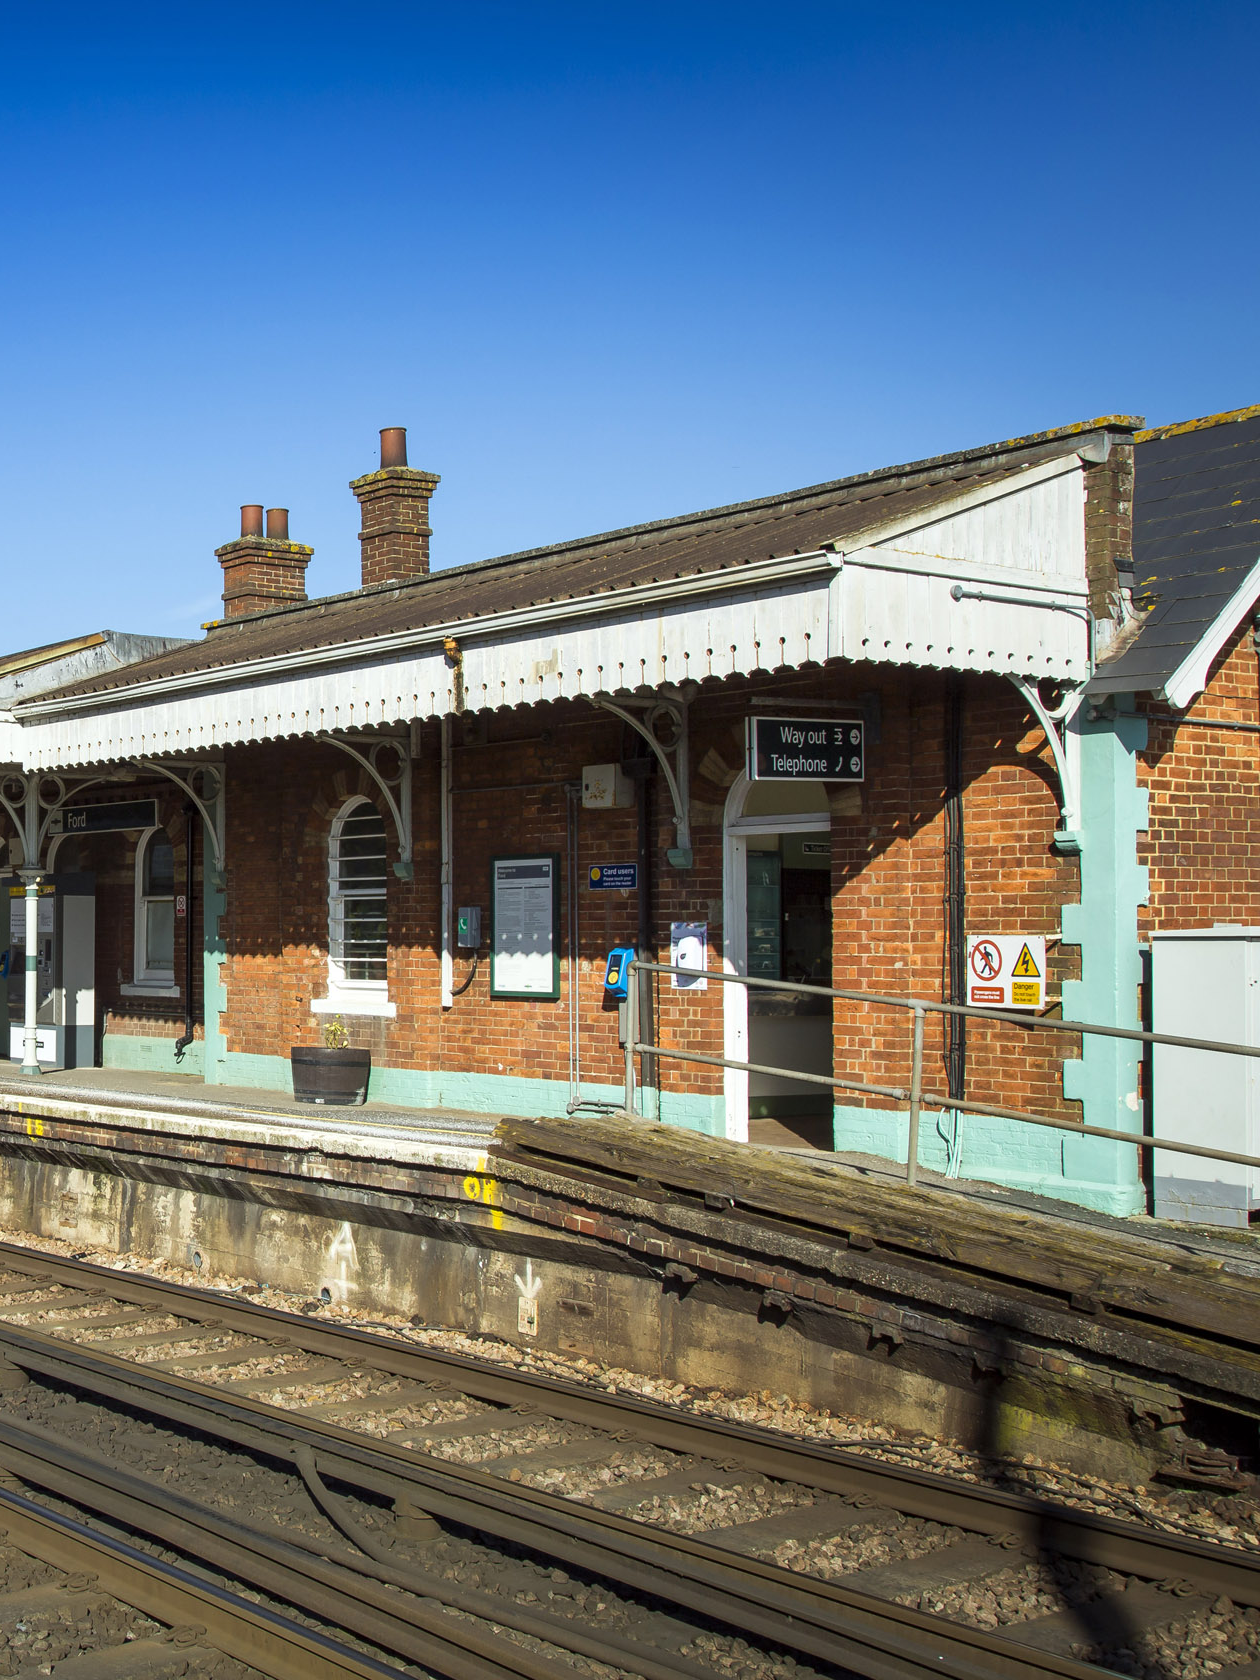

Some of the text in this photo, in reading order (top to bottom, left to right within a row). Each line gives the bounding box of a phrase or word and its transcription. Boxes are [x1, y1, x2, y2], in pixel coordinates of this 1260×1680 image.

[780, 726, 827, 748] Way out
[771, 754, 827, 776] Telephone
[67, 812, 86, 828] Ford
[1013, 983, 1034, 991] Danger
